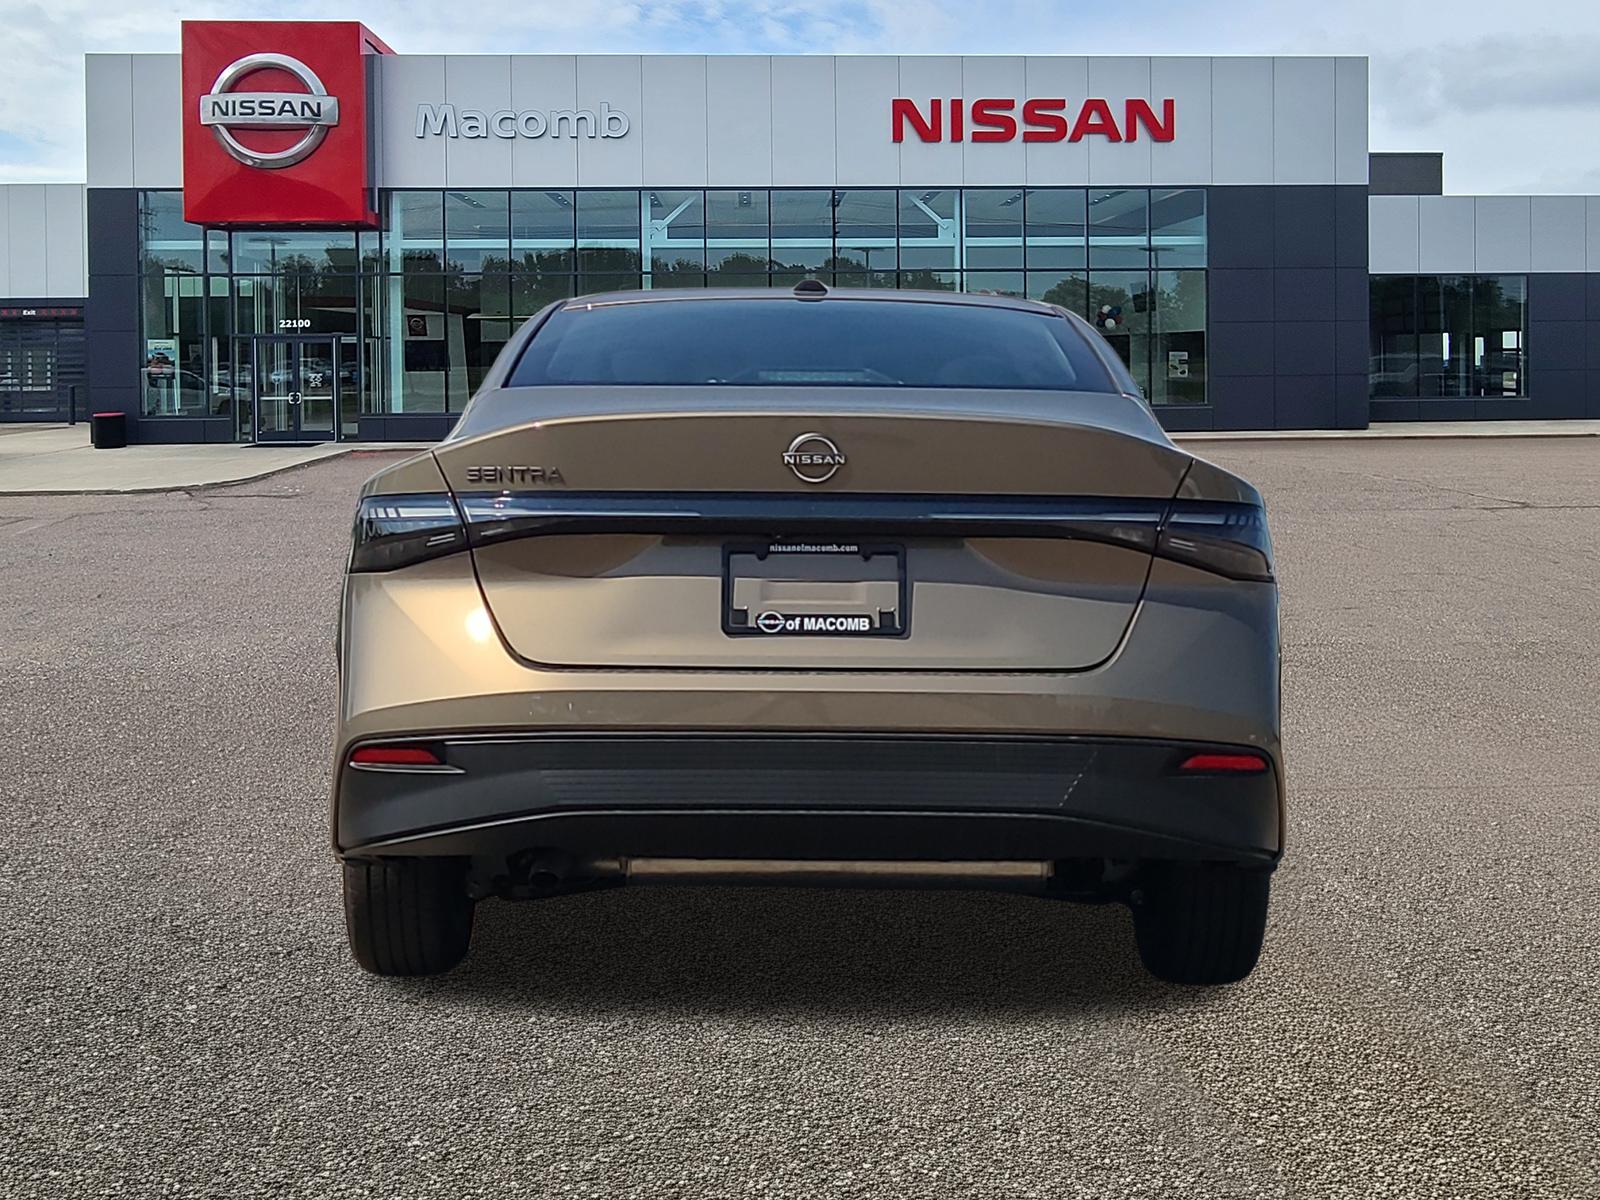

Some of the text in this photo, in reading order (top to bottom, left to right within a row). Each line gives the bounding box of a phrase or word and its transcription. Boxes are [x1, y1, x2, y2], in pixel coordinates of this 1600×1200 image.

[212, 100, 321, 117] NISSAN
[415, 102, 630, 138] Macomb
[892, 98, 1174, 142] NISSAN
[279, 319, 311, 328] 22100
[784, 455, 845, 464] NISSAN
[466, 466, 566, 485] SENTRA
[769, 543, 858, 552] nissanofmacomb.com
[785, 617, 801, 630] of
[803, 618, 870, 630] MACOMB
